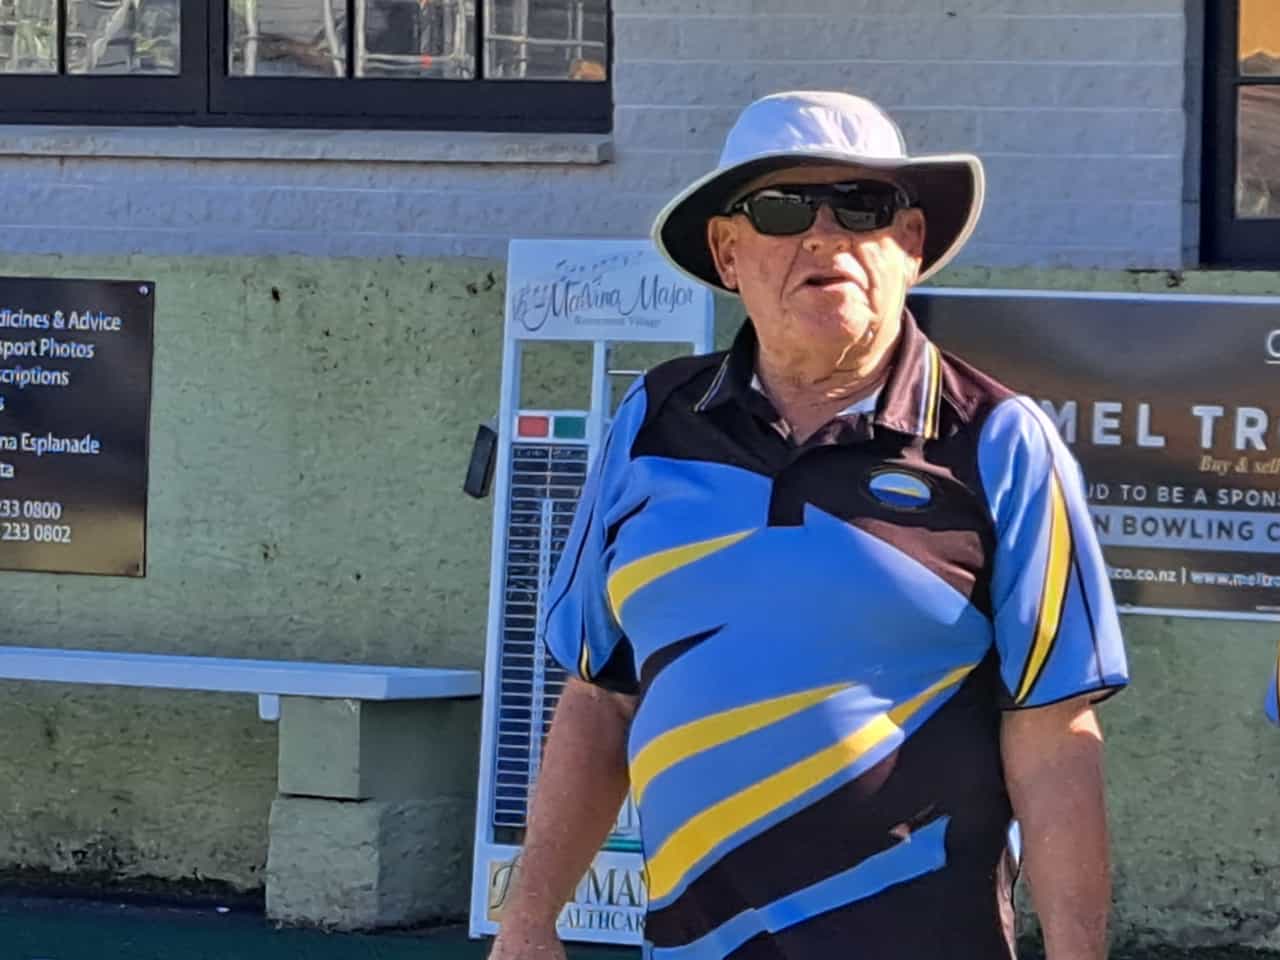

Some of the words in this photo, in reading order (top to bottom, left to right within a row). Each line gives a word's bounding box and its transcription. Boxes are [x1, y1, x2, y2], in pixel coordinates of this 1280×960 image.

[53, 309, 65, 329] &
[68, 310, 121, 331] Advice
[0, 339, 36, 360] port
[39, 337, 95, 359] Photos
[0, 365, 70, 389] criptions
[1039, 400, 1166, 448] MEL
[21, 432, 101, 456] Esplanade
[1199, 455, 1230, 476] Buy
[1234, 457, 1248, 474] &
[1253, 457, 1280, 474] sell
[1120, 484, 1147, 501] TO
[1157, 486, 1184, 503] BE
[1193, 487, 1208, 504] A
[23, 500, 62, 520] 0800
[1, 522, 30, 541] 233
[1122, 515, 1254, 542] BOWLING
